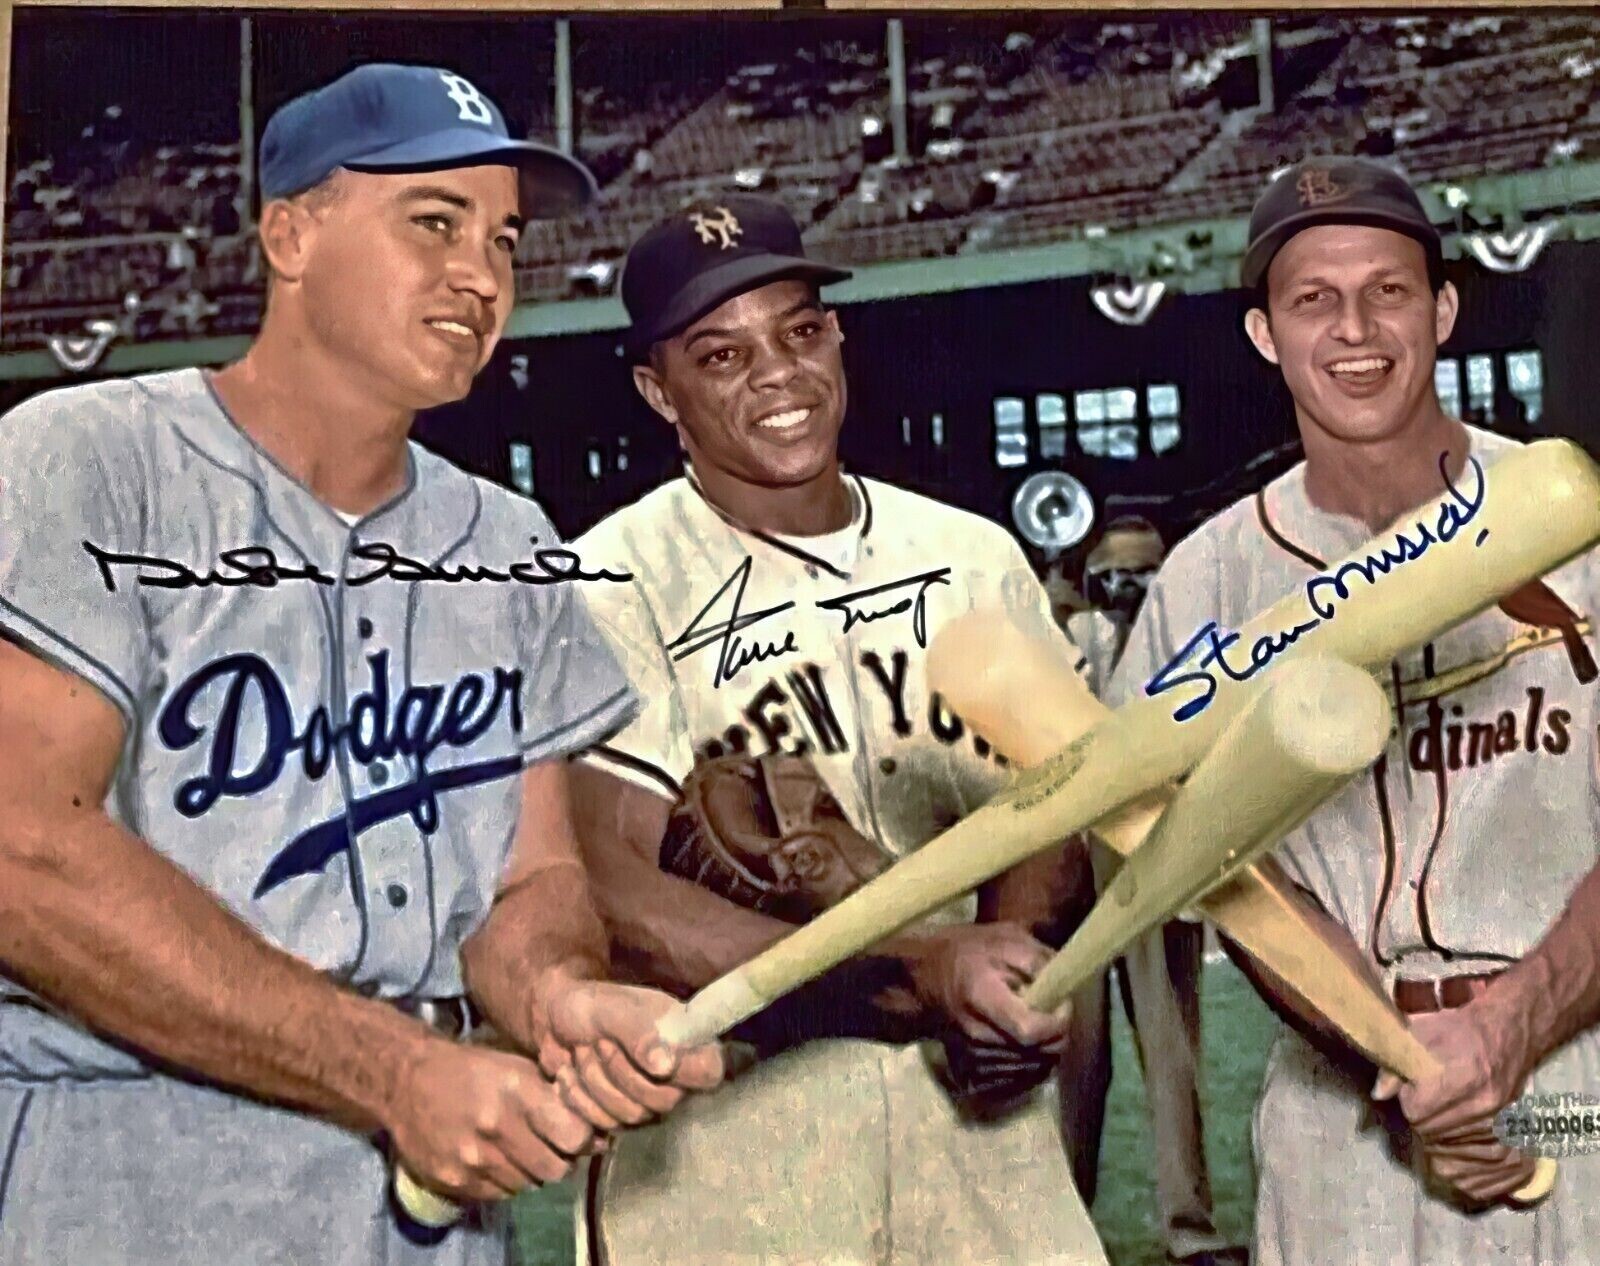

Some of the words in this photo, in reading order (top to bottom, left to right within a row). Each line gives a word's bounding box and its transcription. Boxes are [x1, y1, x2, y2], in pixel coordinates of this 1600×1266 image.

[440, 72, 493, 125] B
[688, 206, 744, 251] NY
[1144, 620, 1321, 723] Stan
